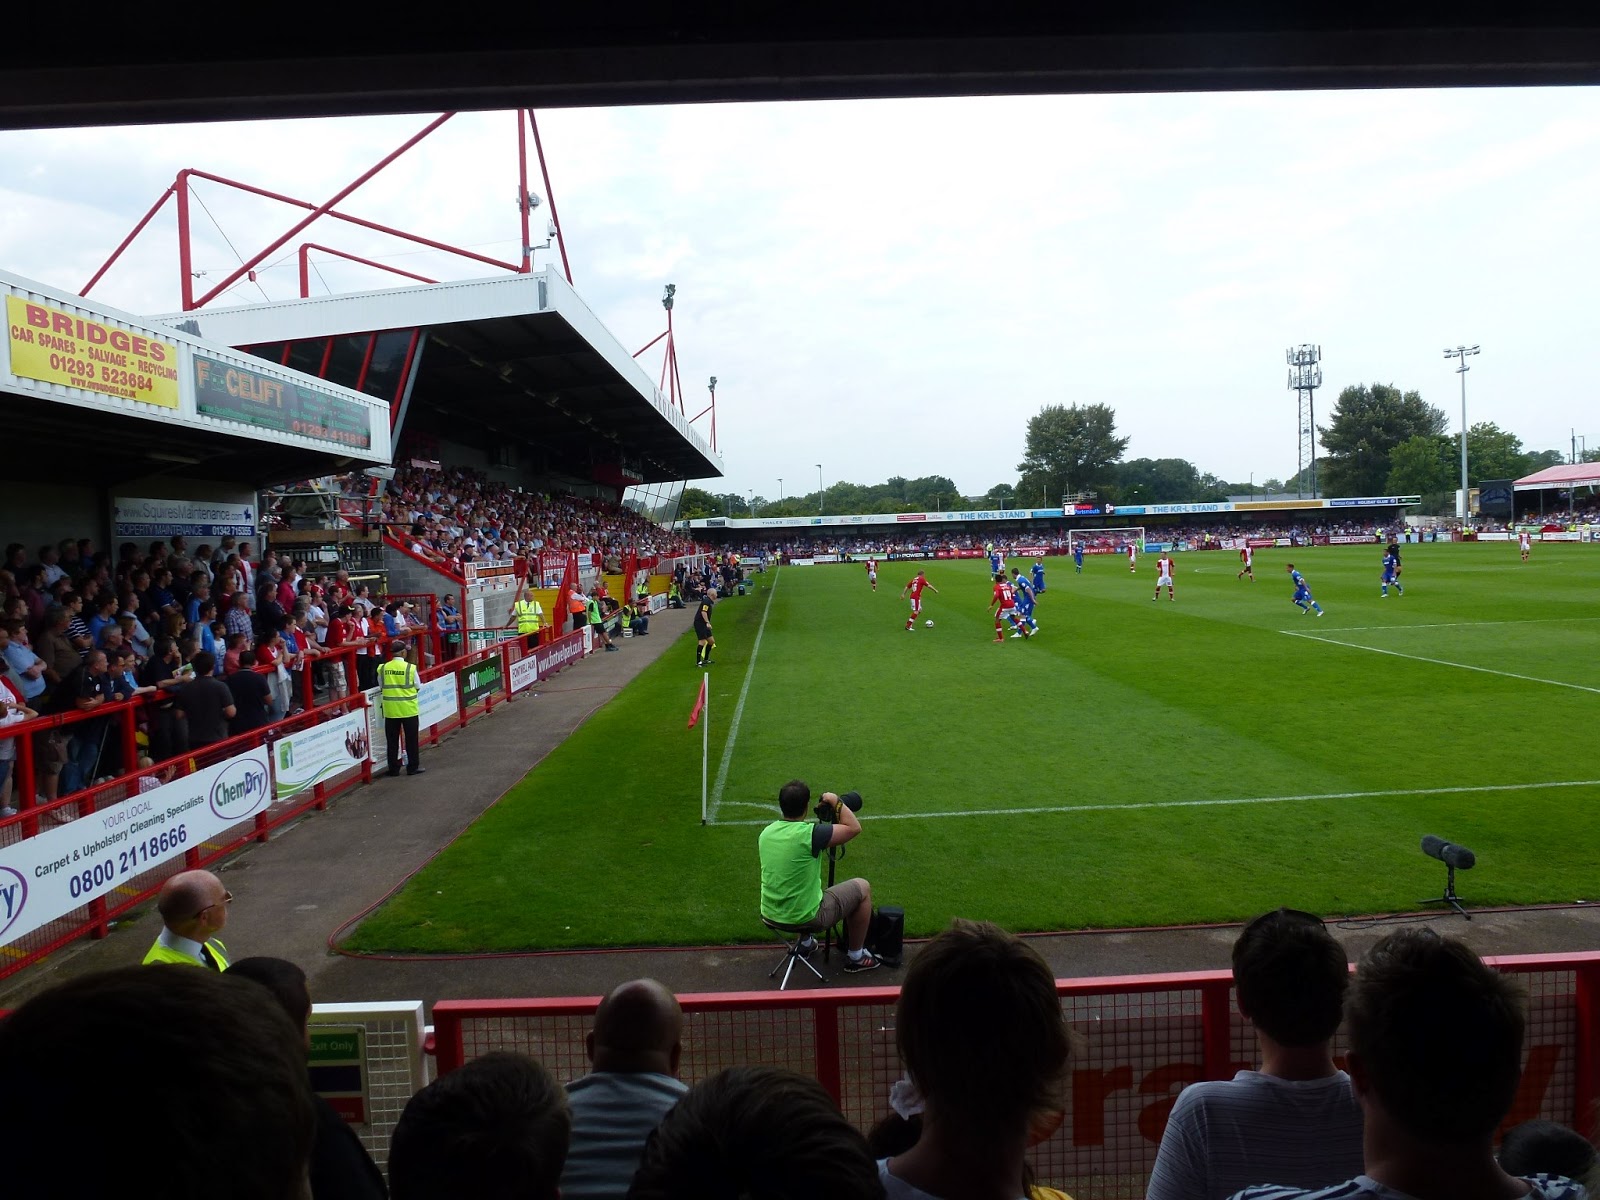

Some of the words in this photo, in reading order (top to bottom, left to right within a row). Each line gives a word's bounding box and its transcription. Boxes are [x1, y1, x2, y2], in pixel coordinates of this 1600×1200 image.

[26, 304, 165, 361] BRIDGES
[11, 325, 34, 343] CAR
[38, 332, 76, 355] SPARES
[88, 346, 127, 367] SALVAGE
[138, 359, 178, 381] RECYCLING
[50, 353, 95, 379] 01293
[101, 366, 153, 391] 523684
[196, 360, 284, 408] FCELIFT
[959, 512, 975, 520] THE
[999, 511, 1026, 519] STAND
[1170, 505, 1189, 513] KR-L
[1192, 504, 1218, 512] STAND
[215, 771, 264, 807] ChemDry
[102, 811, 126, 829] YOUR
[126, 801, 153, 819] LOCAL
[35, 855, 71, 878] Carpet
[73, 850, 80, 862] &
[83, 828, 128, 857] Upholstery
[130, 812, 165, 834] Cleaning
[166, 794, 204, 819] Specialists
[69, 859, 114, 899] 0800
[119, 823, 187, 875] 2118666
[330, 1041, 354, 1052] Only
